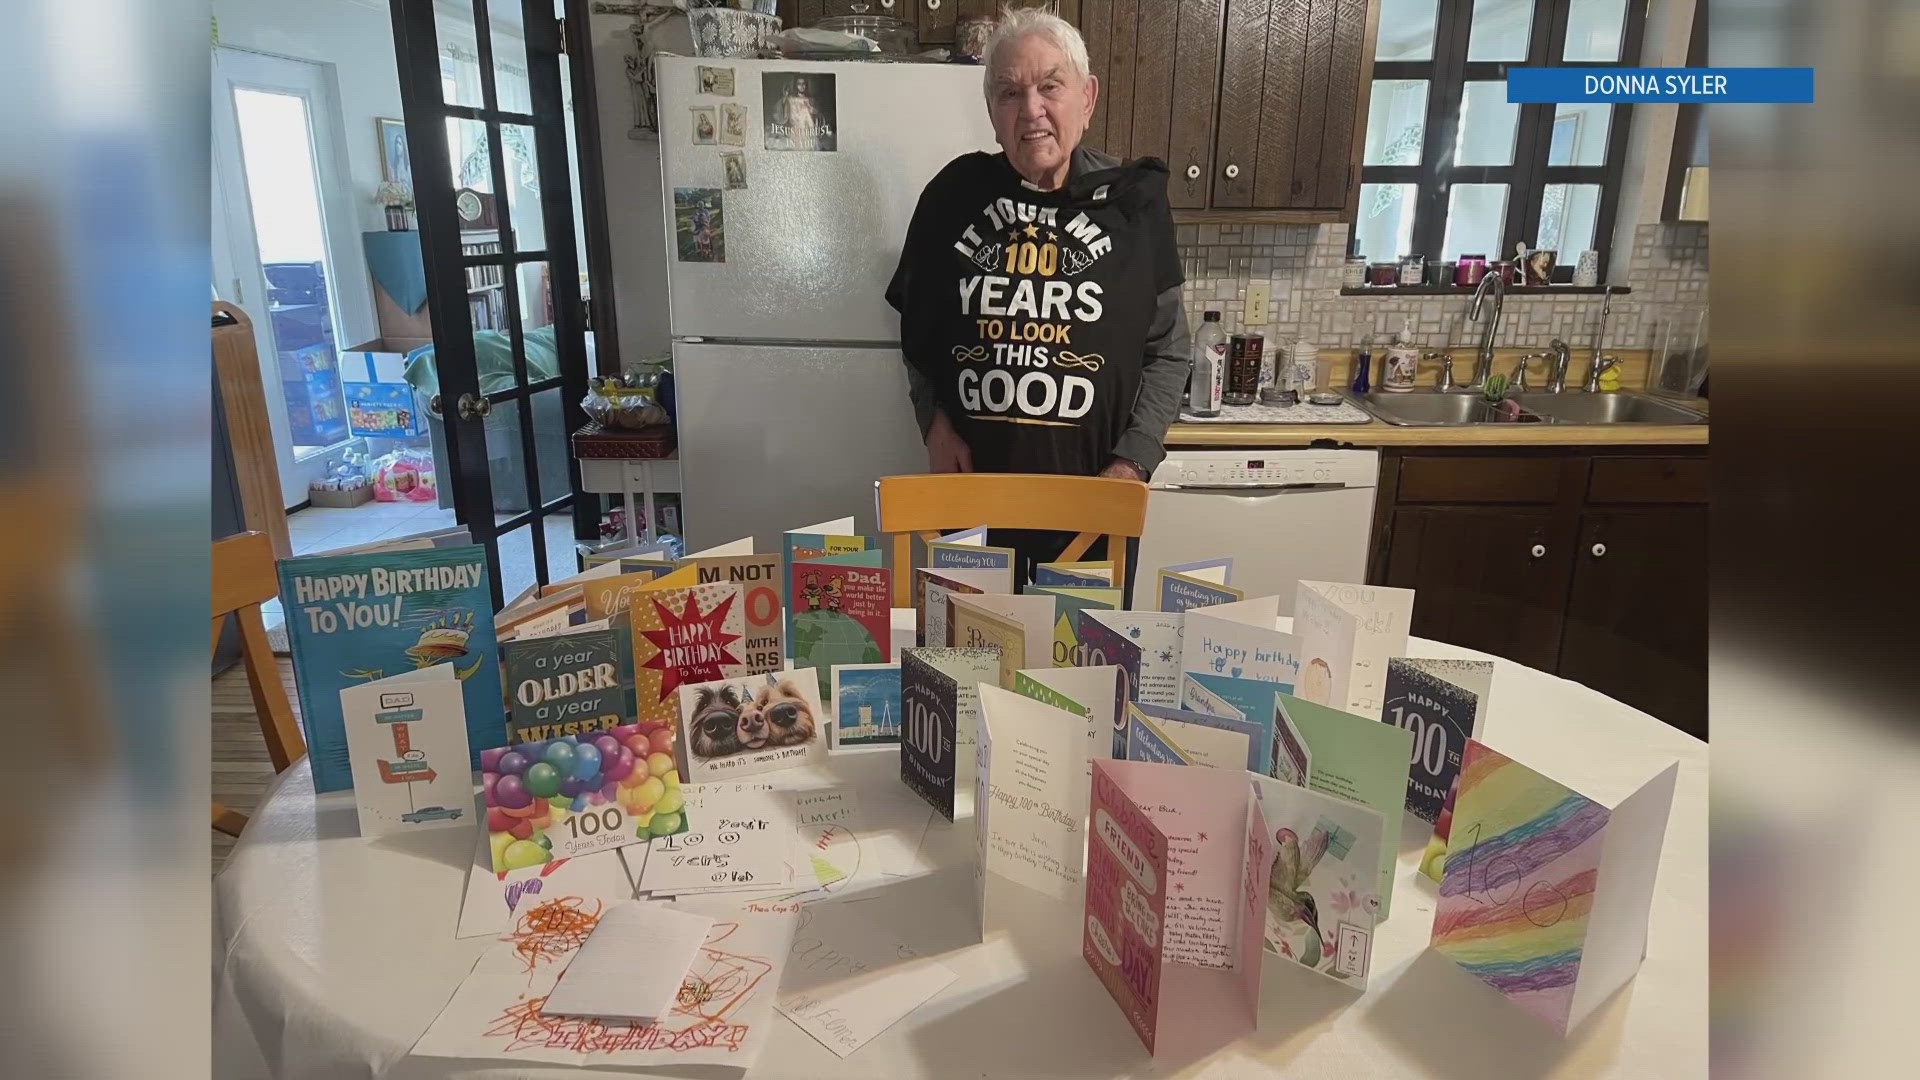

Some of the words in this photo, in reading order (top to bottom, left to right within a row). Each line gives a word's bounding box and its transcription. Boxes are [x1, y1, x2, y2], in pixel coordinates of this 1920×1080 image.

[770, 123, 795, 136] JESUS
[954, 224, 983, 258] IT
[1064, 211, 1112, 260] ME
[1005, 241, 1058, 276] 100
[959, 275, 1104, 322] YEARS
[976, 319, 1003, 339] TO
[1010, 321, 1072, 344] LOOK
[993, 343, 1049, 368] THIS
[958, 368, 1095, 419] GOOD
[295, 574, 368, 604] HAPPY
[371, 563, 482, 597] BIRTHDAY
[730, 564, 775, 581] NOT
[847, 571, 885, 586] Dad,
[304, 606, 338, 634] TO
[336, 596, 403, 631] YOU!
[669, 620, 714, 646] HAPPY
[745, 637, 778, 648] WITH
[535, 657, 547, 668] a
[553, 651, 592, 670] year
[664, 642, 723, 668] BIRTHDAY
[746, 652, 778, 666] ARS
[1204, 637, 1247, 663] Happy
[678, 667, 689, 677] To
[692, 665, 711, 675] You
[517, 662, 619, 707] OLDER
[914, 683, 941, 706] HAPPY
[536, 706, 549, 719] a
[556, 698, 601, 721] year
[1408, 692, 1449, 717] HAPPY
[906, 696, 942, 764] 100
[908, 754, 946, 787] BIRTHDAY
[1408, 778, 1447, 799] THDAY
[989, 783, 1018, 810] Happy
[1038, 802, 1078, 833] Birthday
[563, 807, 622, 839] 100
[565, 841, 595, 853] Years
[596, 833, 626, 846] Today
